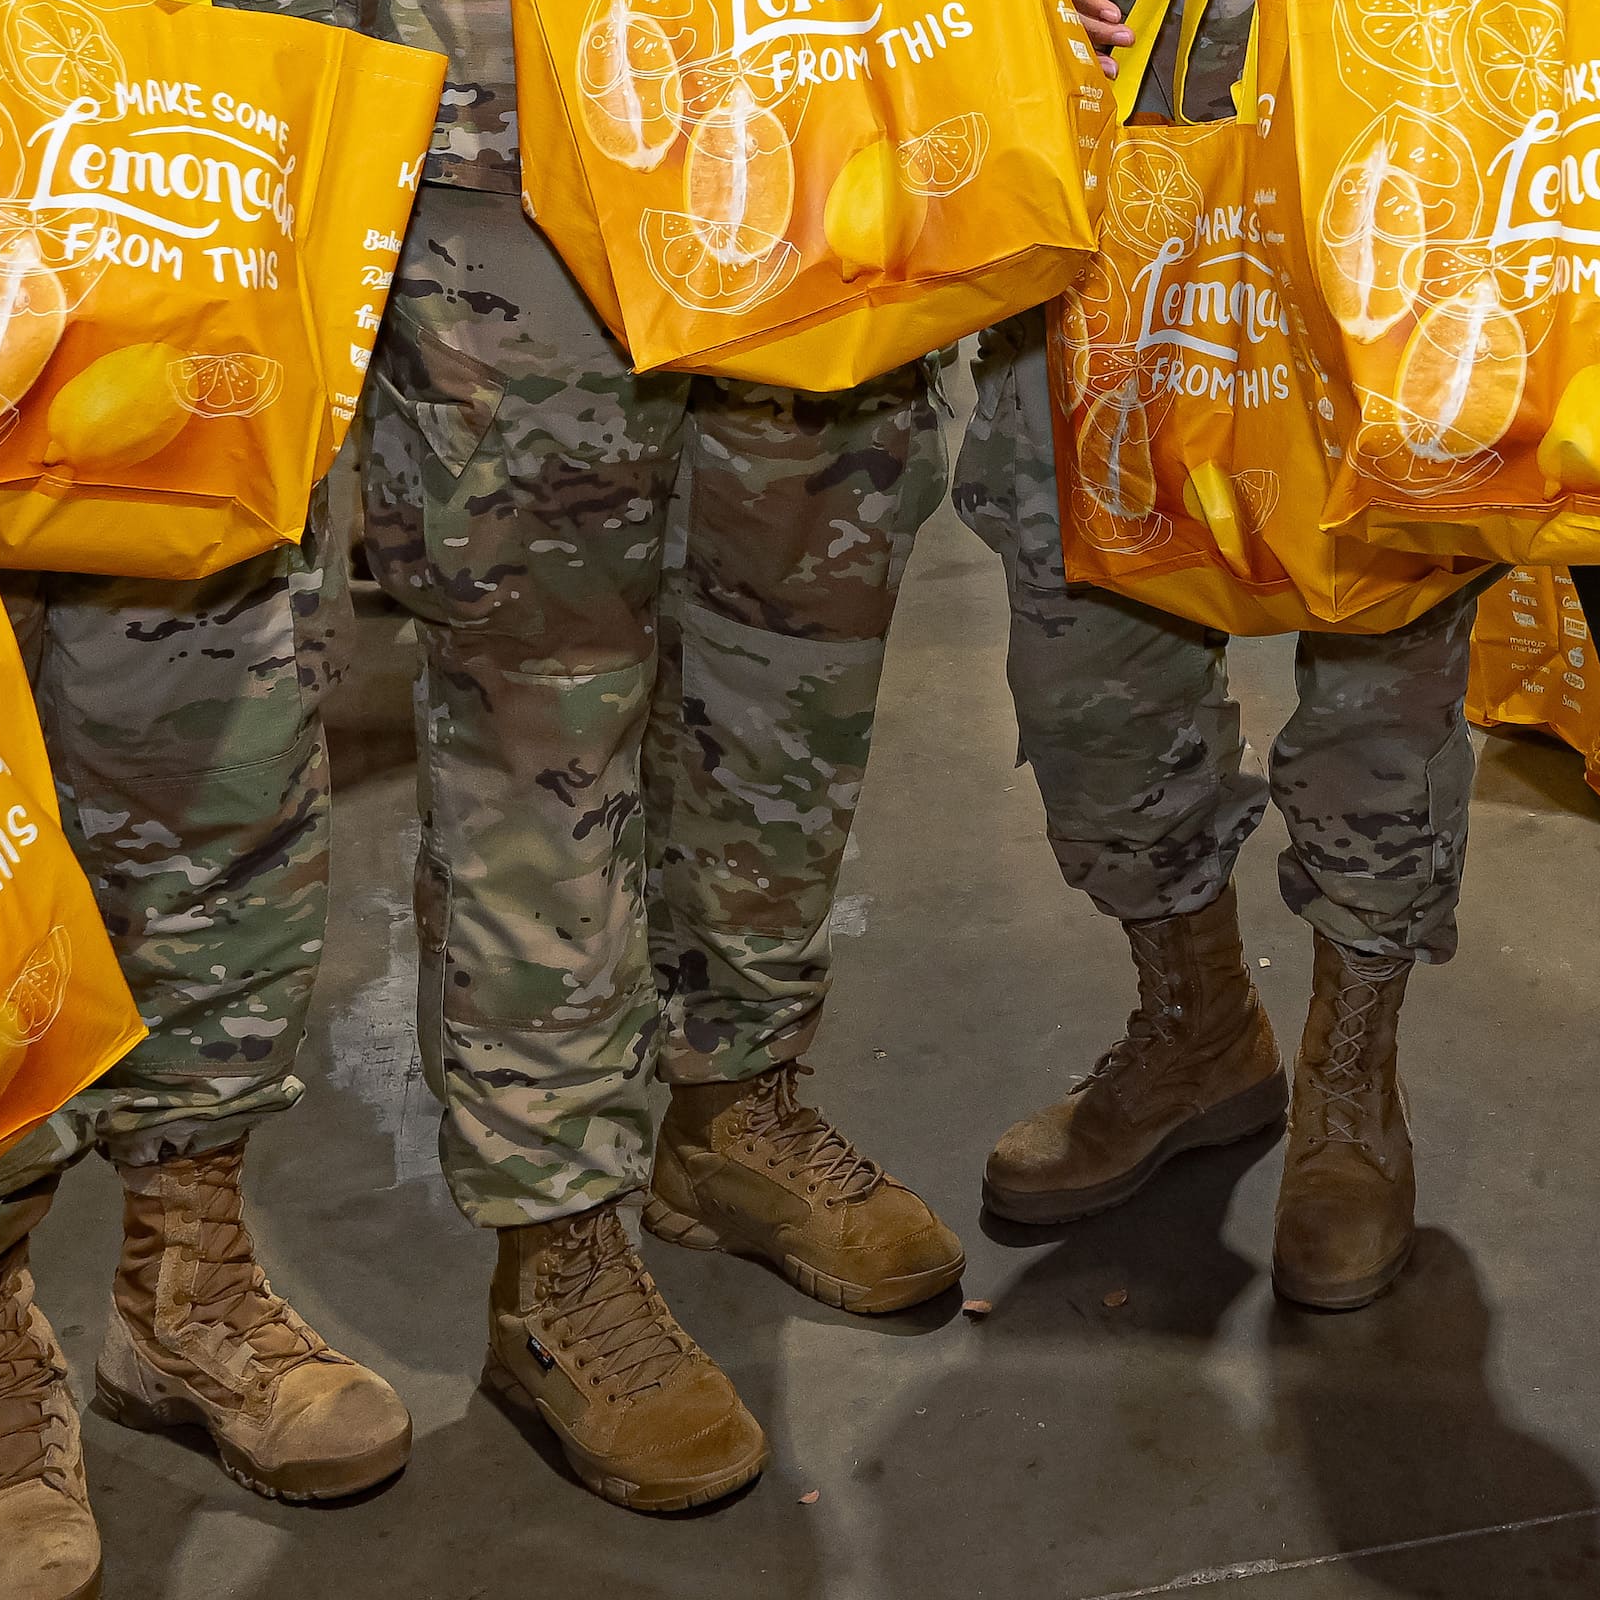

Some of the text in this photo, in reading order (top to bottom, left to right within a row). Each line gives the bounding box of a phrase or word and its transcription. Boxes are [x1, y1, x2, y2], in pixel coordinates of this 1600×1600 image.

[769, 1, 974, 93] FROM THIS
[114, 79, 290, 148] MAKE SOME
[26, 96, 298, 241] Lemonade
[63, 222, 280, 291] FROM THIS
[1236, 363, 1290, 409] HIS
